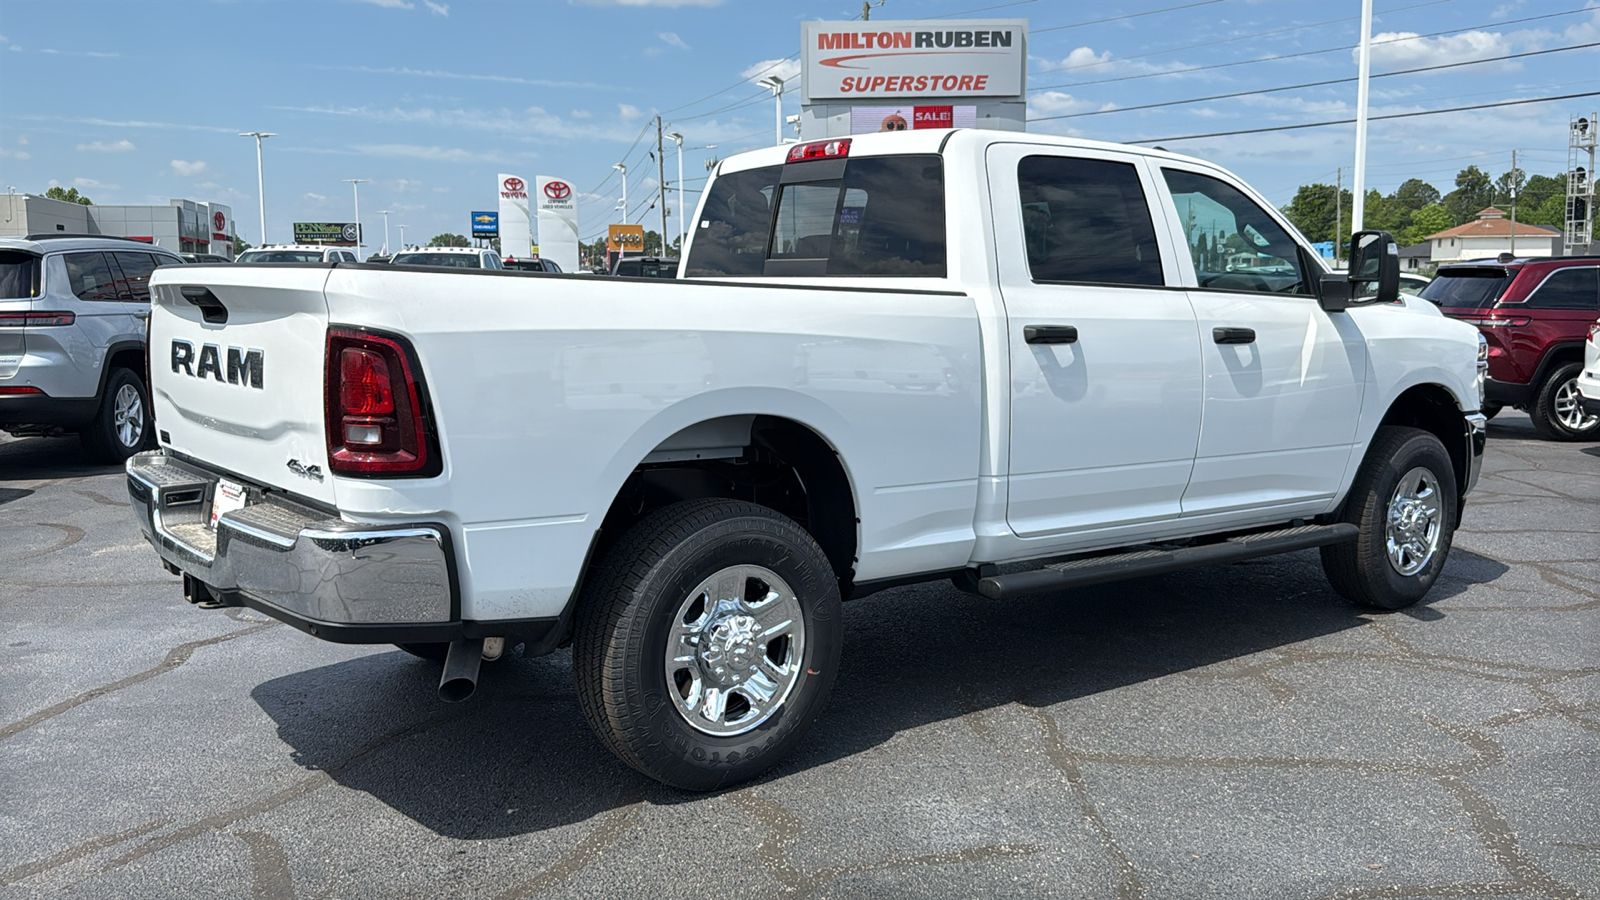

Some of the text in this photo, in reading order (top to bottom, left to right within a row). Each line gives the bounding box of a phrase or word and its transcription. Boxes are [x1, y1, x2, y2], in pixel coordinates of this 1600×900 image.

[818, 31, 1012, 50] MILTON RUBEN
[840, 75, 989, 92] SUPERSTORE
[500, 191, 528, 200] TOYOTA
[612, 231, 642, 245] Jeep
[171, 338, 265, 390] RAM
